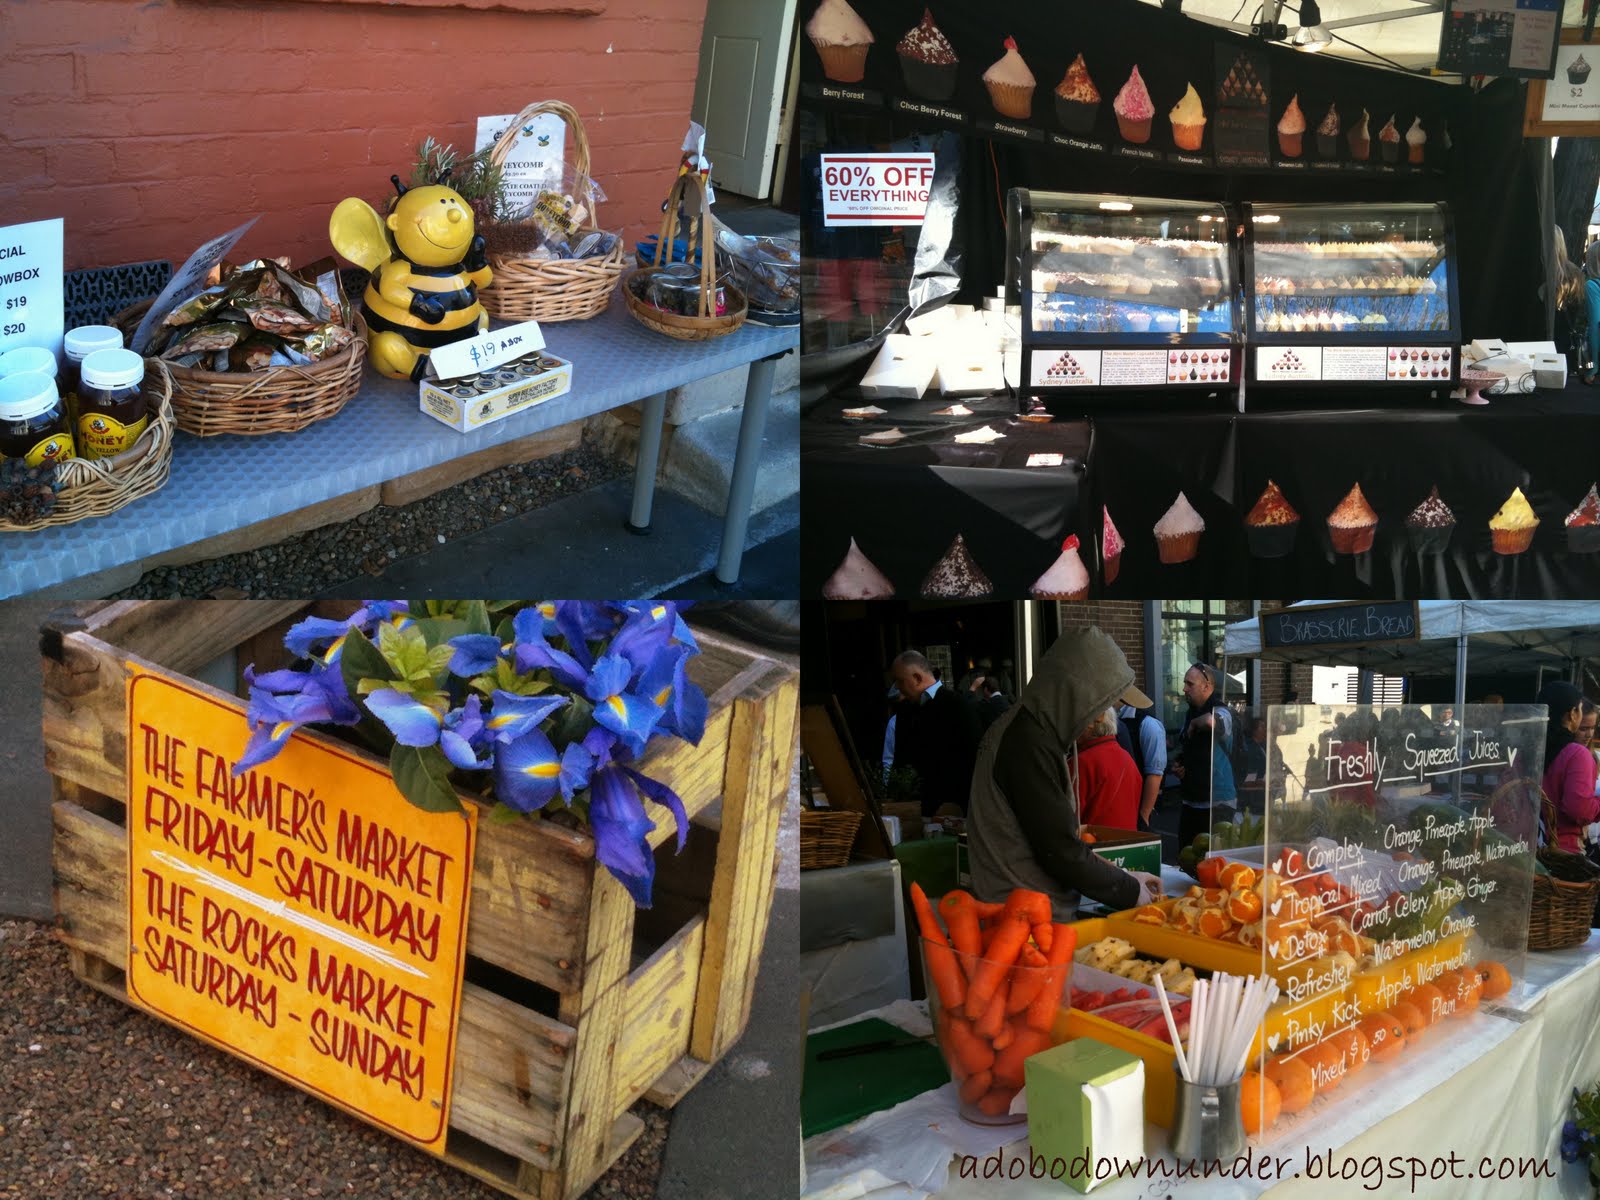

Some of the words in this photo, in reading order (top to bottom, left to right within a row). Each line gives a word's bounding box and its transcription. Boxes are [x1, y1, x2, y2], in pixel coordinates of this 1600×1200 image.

[823, 87, 841, 99] Berry
[842, 90, 865, 100] Forest
[1570, 87, 1583, 97] $2
[900, 101, 919, 111] Choc
[920, 105, 940, 117] Berry
[940, 109, 962, 120] Forest
[994, 122, 1028, 136] Strawberry
[1053, 136, 1068, 145] Choc
[1069, 139, 1089, 149] Orange
[1121, 147, 1138, 155] French
[825, 166, 875, 187] 60%
[884, 166, 933, 186] OFF
[829, 189, 929, 202] EVERYTHING
[6, 296, 27, 310] $19
[4, 322, 26, 336] $20
[470, 341, 496, 367] $19
[1280, 614, 1360, 643] BRASSERIE
[1364, 606, 1414, 637] BREAD
[1325, 737, 1386, 790] Freshly
[1403, 733, 1460, 782] Squeezed
[140, 724, 187, 788] THE
[196, 748, 328, 854] FARMER'S
[336, 809, 454, 903] MARKET
[1286, 851, 1299, 877] C
[1307, 837, 1363, 875] Complex
[145, 786, 255, 878] FRIDAY
[274, 847, 441, 962] SATURDAY
[1285, 882, 1341, 922] Tropical
[1350, 870, 1382, 899] Mixed
[142, 868, 196, 934] THE
[202, 897, 298, 983] ROCKS
[307, 947, 435, 1046] MARKET
[1282, 930, 1327, 961] Detox
[144, 926, 277, 1028] SATURDAY
[309, 1008, 425, 1100] SUNDAY
[1287, 1012, 1326, 1051] Pinky
[1332, 993, 1362, 1028] Kick
[1311, 1051, 1348, 1092] Mixed
[1431, 997, 1456, 1023] Plain
